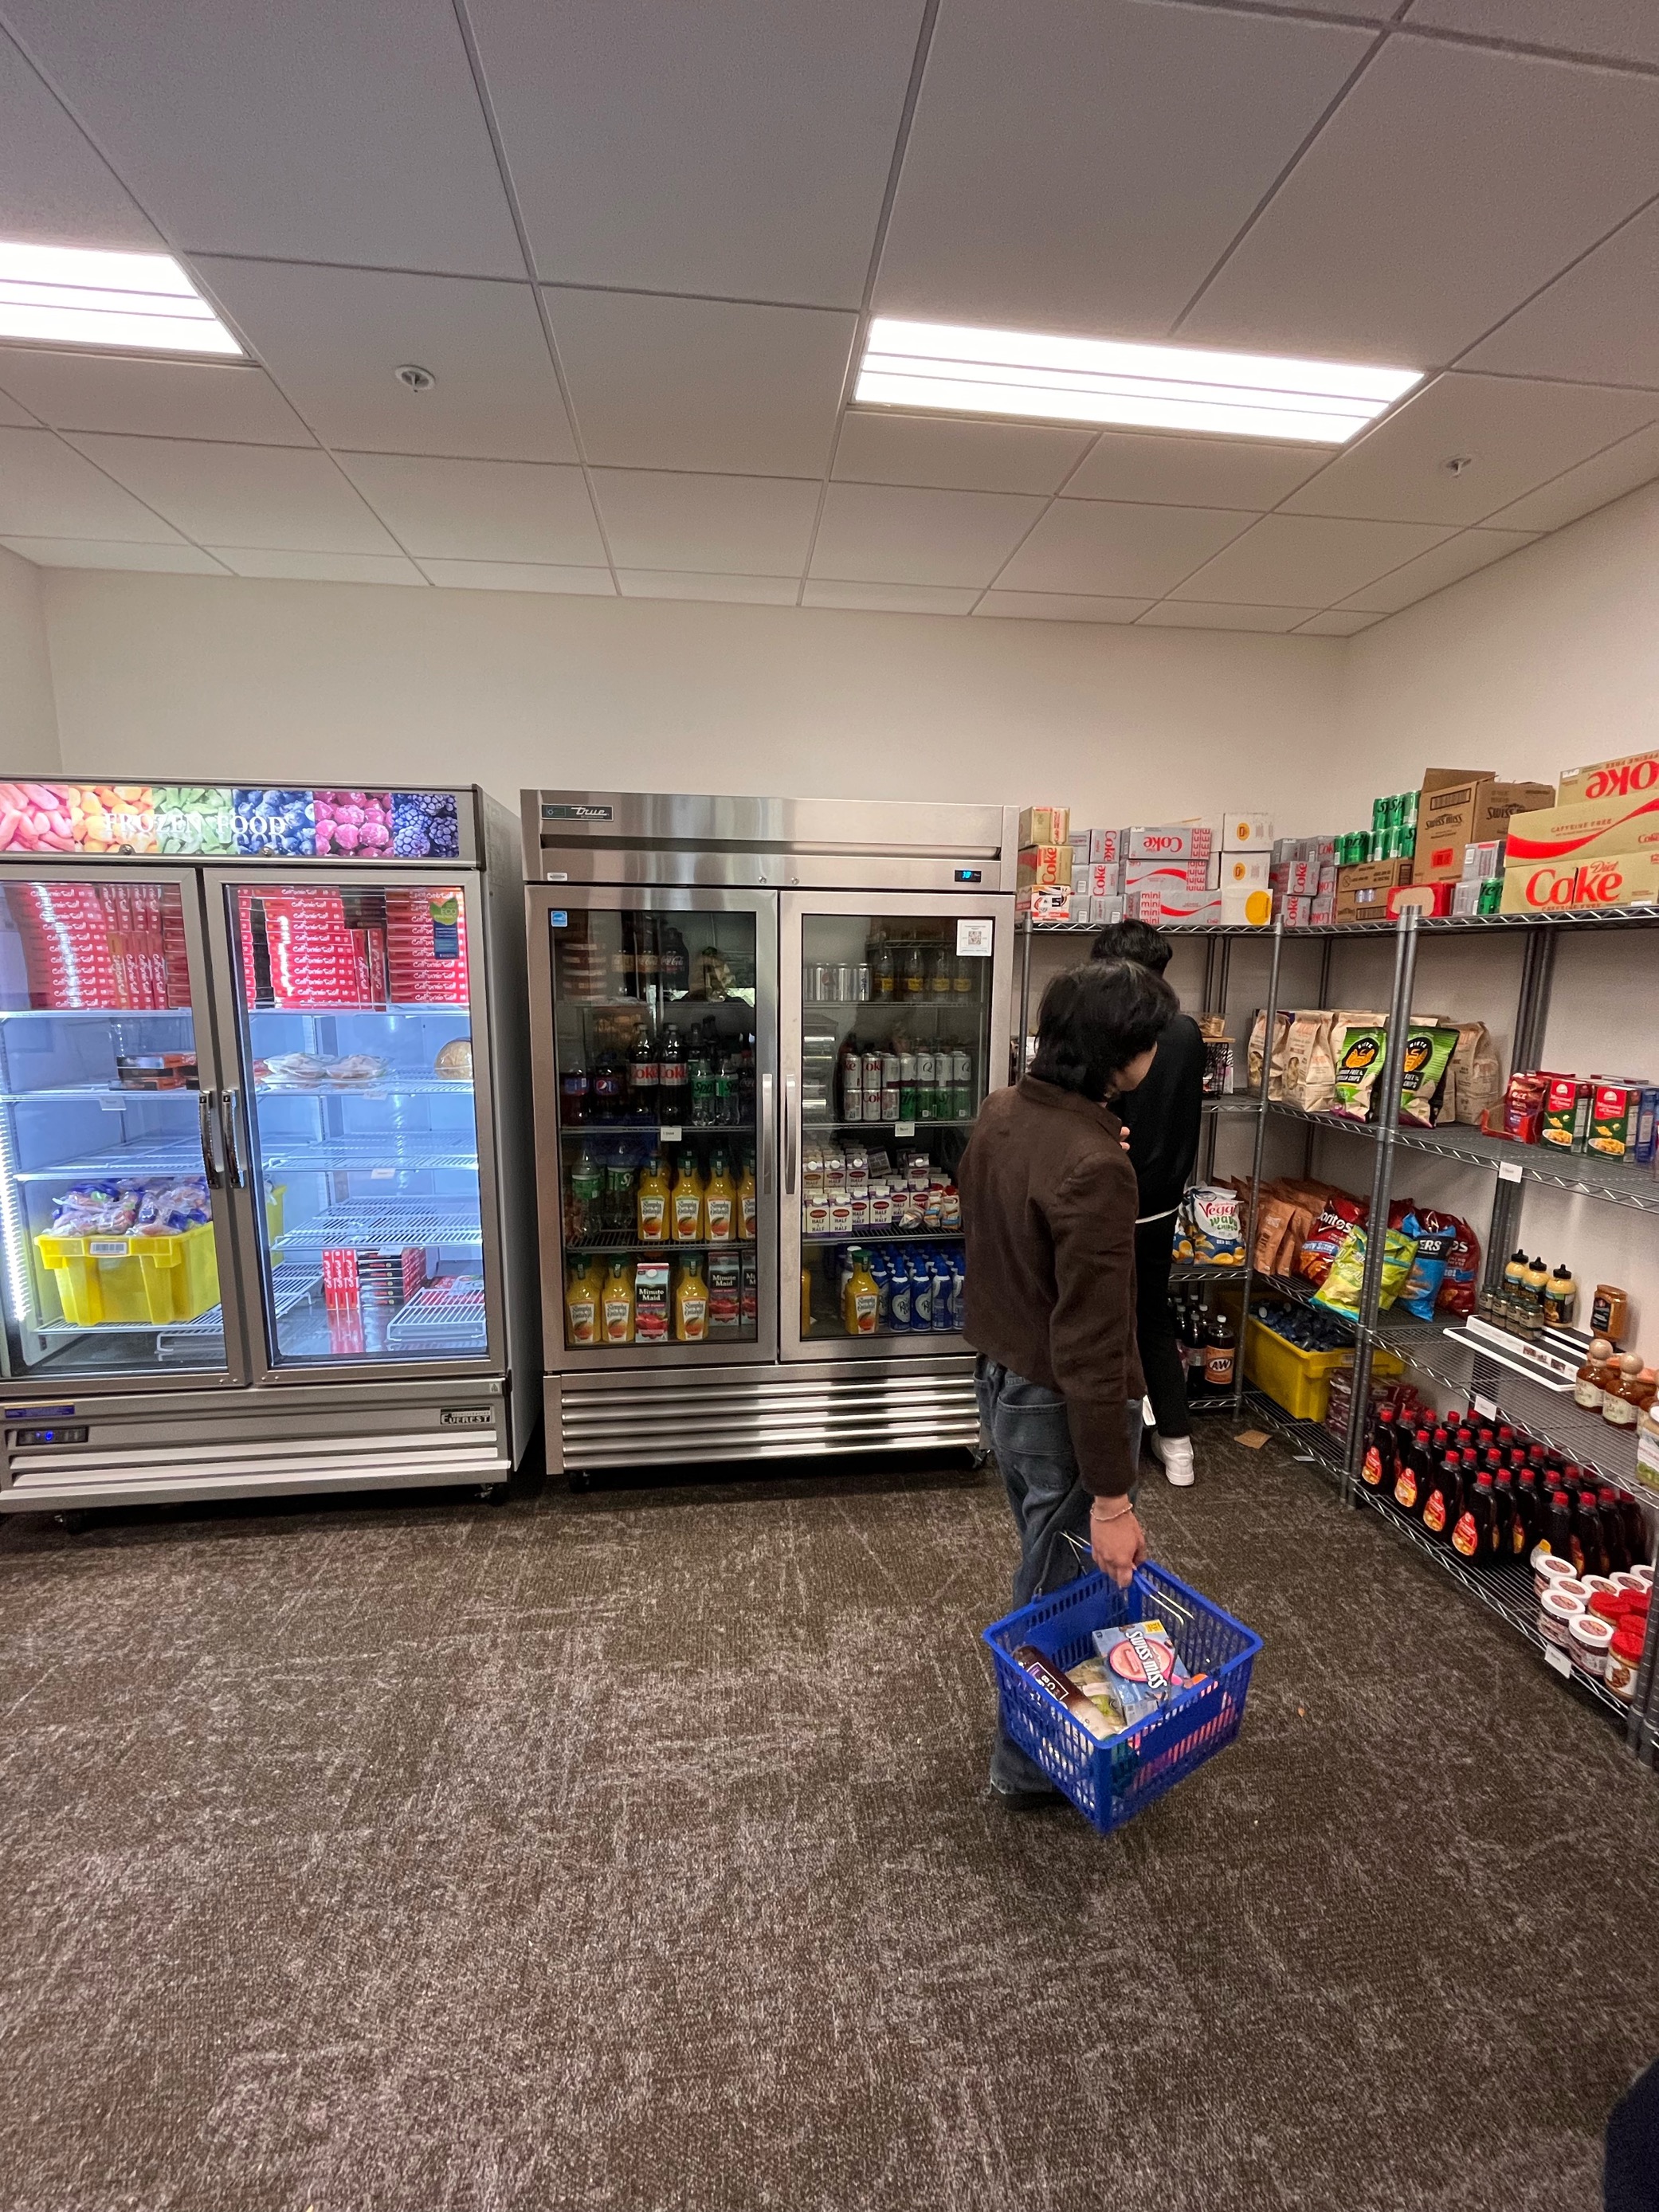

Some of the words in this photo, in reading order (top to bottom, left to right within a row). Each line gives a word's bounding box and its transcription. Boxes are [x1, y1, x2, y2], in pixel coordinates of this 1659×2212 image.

[104, 813, 203, 833] FROZEN
[215, 815, 287, 835] FOOD
[1104, 830, 1116, 862] Coke
[1143, 836, 1183, 853] Coke
[1042, 847, 1057, 884] Coke
[1092, 865, 1106, 896] Coke
[1293, 862, 1308, 893] Coke
[1590, 860, 1618, 873] Diet
[1525, 865, 1622, 907] Coke
[1284, 896, 1298, 927] Coke
[923, 1061, 933, 1073] Q
[1125, 1630, 1153, 1661] SWISS
[1142, 1660, 1168, 1689] MISS
